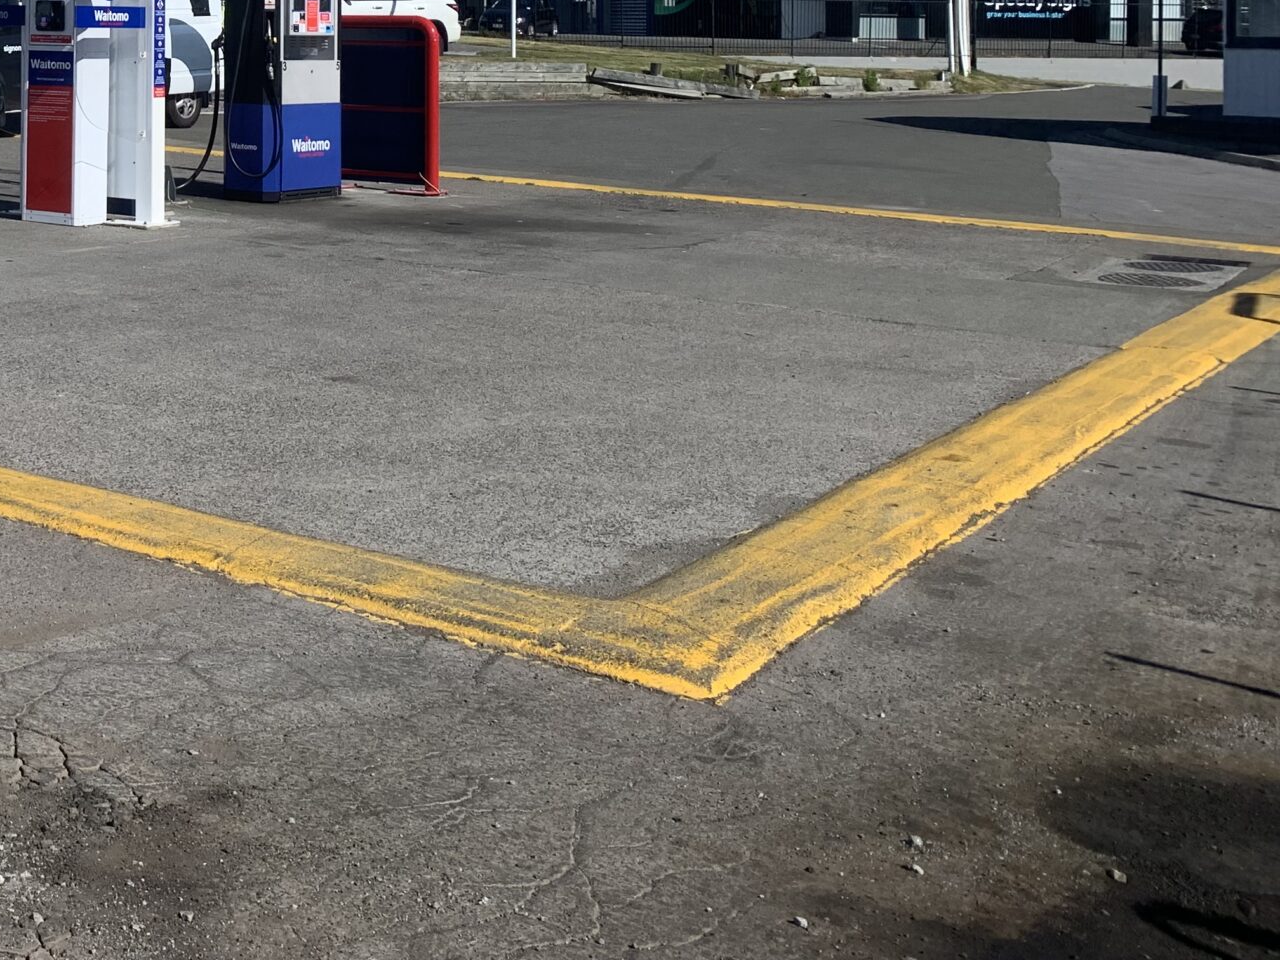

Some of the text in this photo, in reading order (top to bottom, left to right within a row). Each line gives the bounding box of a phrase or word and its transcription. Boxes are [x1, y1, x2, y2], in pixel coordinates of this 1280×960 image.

[94, 7, 129, 22] Waitomo
[30, 58, 72, 70] Waitomo
[282, 61, 287, 71] 3
[231, 142, 258, 151] Waitomo
[292, 138, 331, 153] Waitomo
